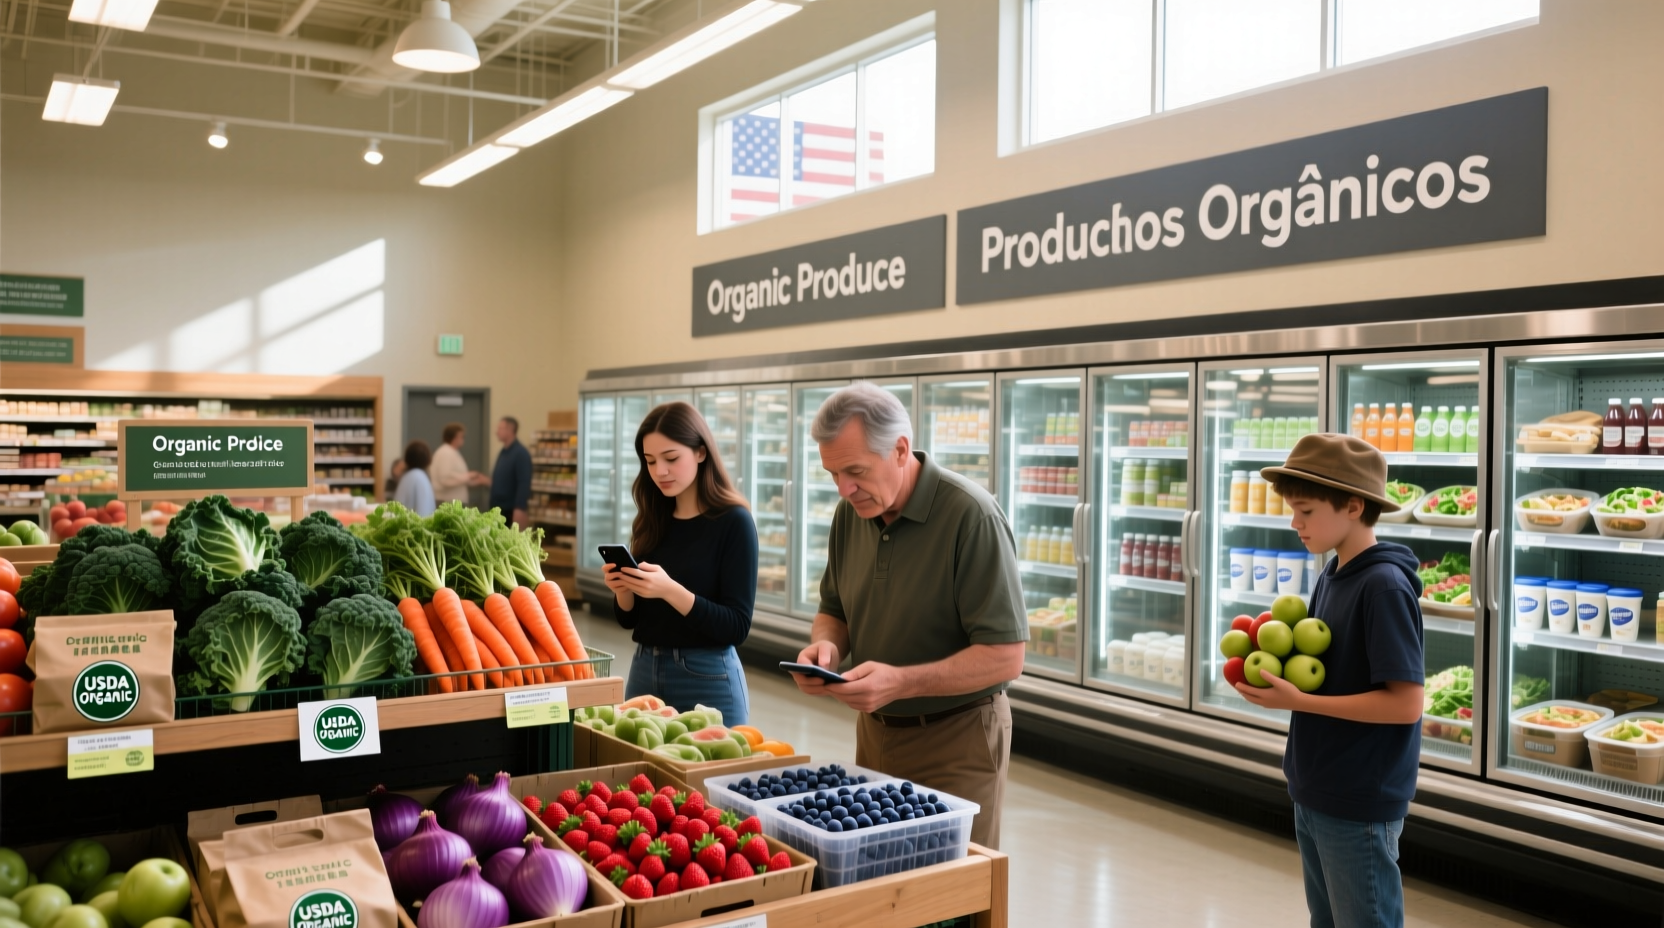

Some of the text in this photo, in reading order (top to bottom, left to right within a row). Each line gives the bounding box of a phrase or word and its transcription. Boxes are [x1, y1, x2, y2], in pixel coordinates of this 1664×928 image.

[981, 154, 1491, 273] Produchos Orgânicos
[707, 252, 906, 323] Organic Produce
[152, 435, 221, 457] Organic
[84, 675, 130, 691] USDA
[298, 900, 346, 920] USDA
